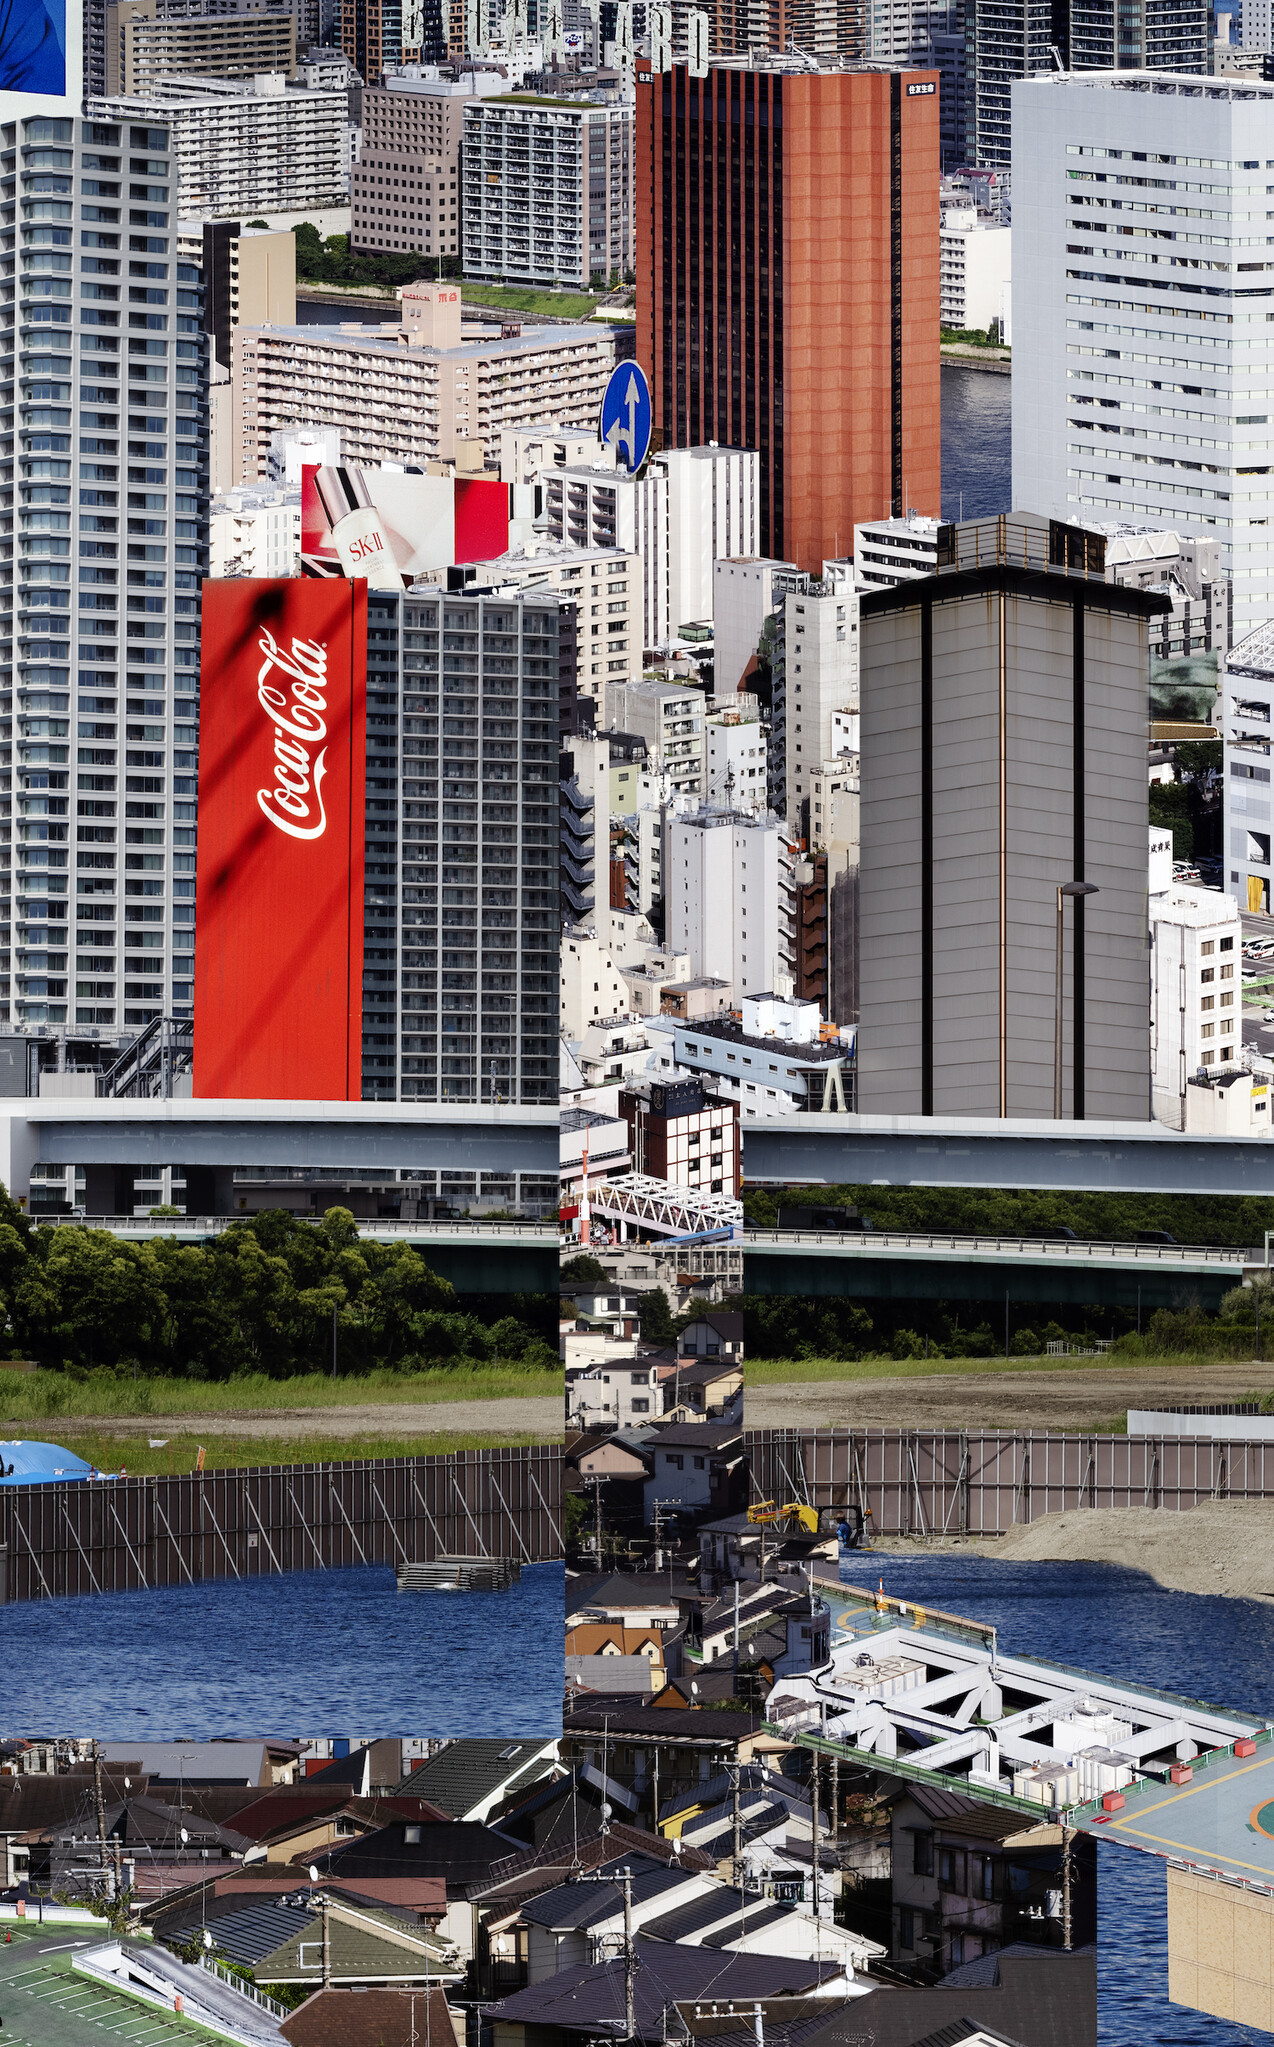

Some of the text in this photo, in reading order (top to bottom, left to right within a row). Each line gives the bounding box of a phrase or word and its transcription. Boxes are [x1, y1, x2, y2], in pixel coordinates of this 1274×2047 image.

[908, 83, 934, 95] 住友生命
[349, 532, 384, 562] SK-II
[256, 625, 328, 840] Coca-Cola
